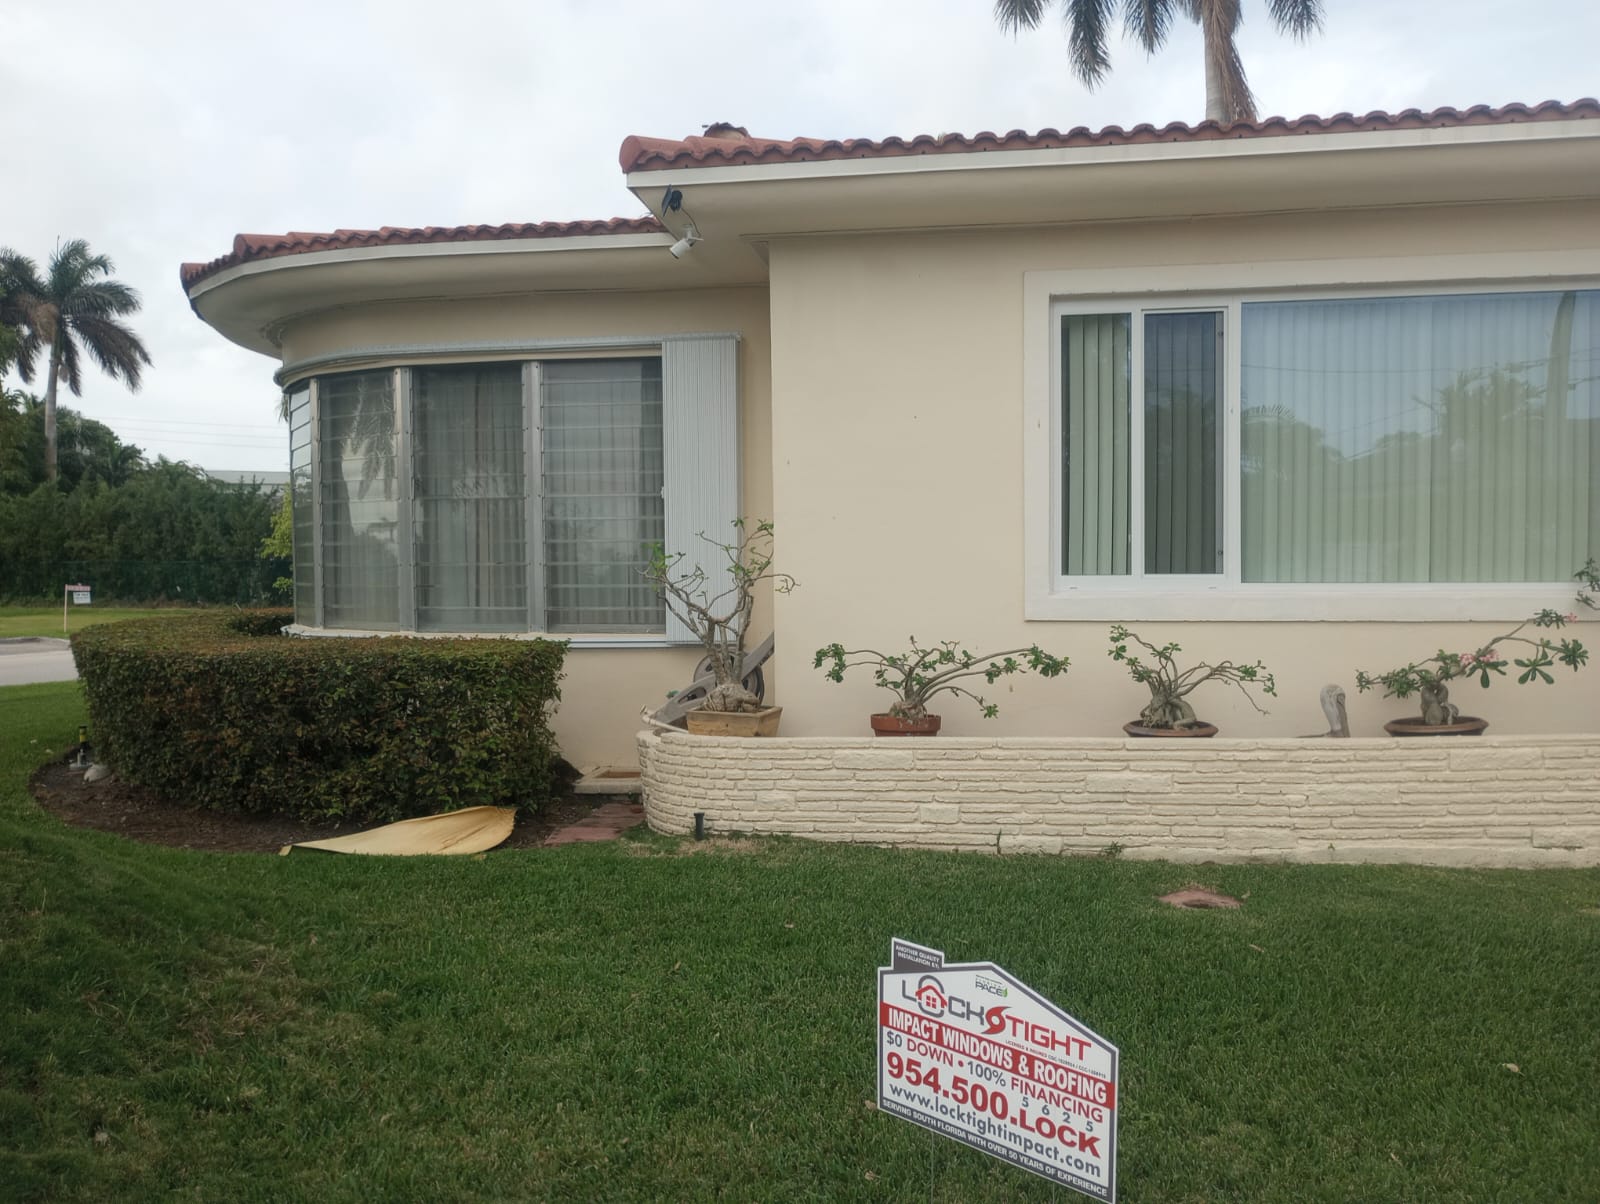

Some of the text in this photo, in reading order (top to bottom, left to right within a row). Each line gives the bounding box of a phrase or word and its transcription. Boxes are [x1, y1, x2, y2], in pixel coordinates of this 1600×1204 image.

[896, 945, 940, 964] ANOTHER QUALITY
[897, 951, 931, 967] INSTALLATION
[975, 981, 1003, 997] PACE
[888, 1007, 1107, 1104] IMPACT WINDOWS & ROOFING
[902, 974, 1092, 1061] LOCK TIGHT
[886, 1030, 1103, 1123] $0 DOWN 100% FINANCING
[886, 1051, 1101, 1159] 954.500.LOCK
[1021, 1096, 1094, 1132] 5 6 2 5
[883, 1098, 1108, 1197] SERVING SOUTH FLORIDA WITH OVER 50 YEARS OF EXPERIENCE
[889, 1083, 1101, 1177] www.locktightimpact.com
